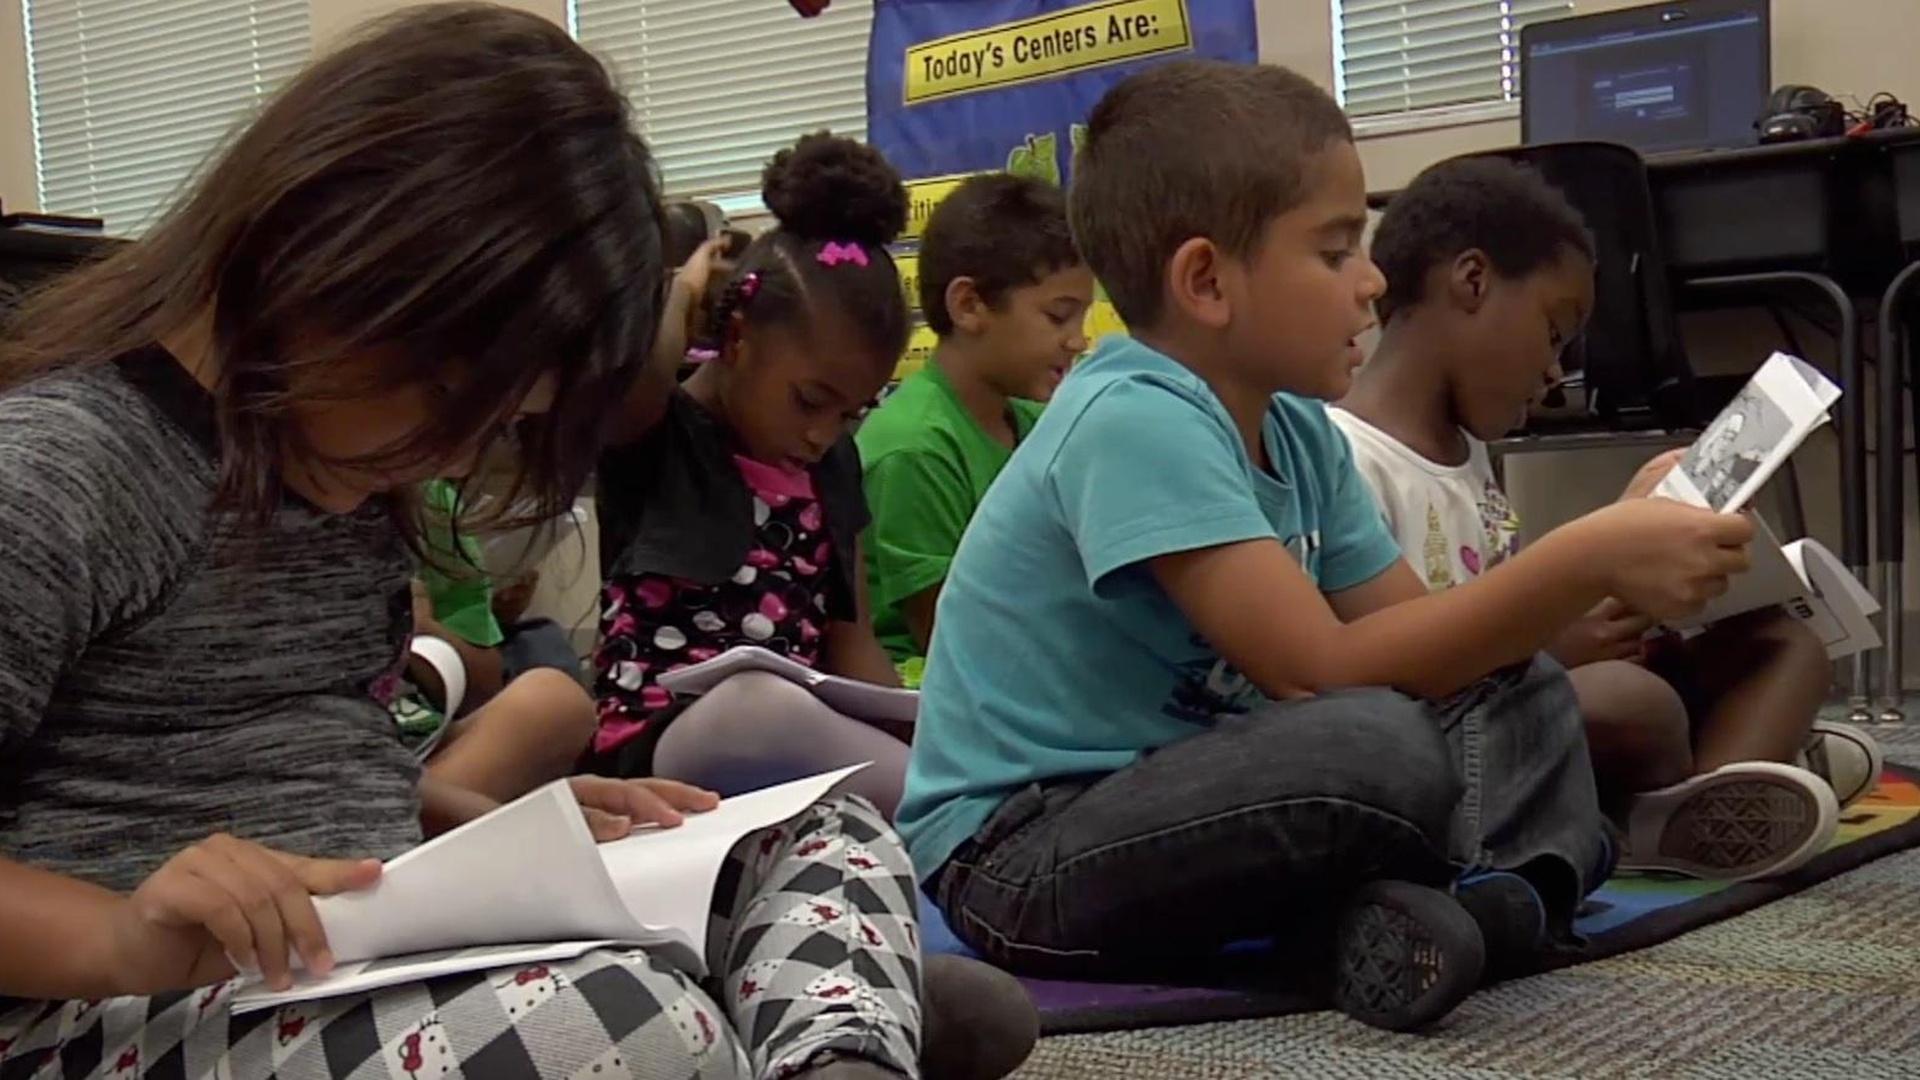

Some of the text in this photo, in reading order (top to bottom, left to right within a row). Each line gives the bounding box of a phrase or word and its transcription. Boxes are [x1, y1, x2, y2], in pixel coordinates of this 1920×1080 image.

[923, 13, 1160, 82] Today's Centers Are:
